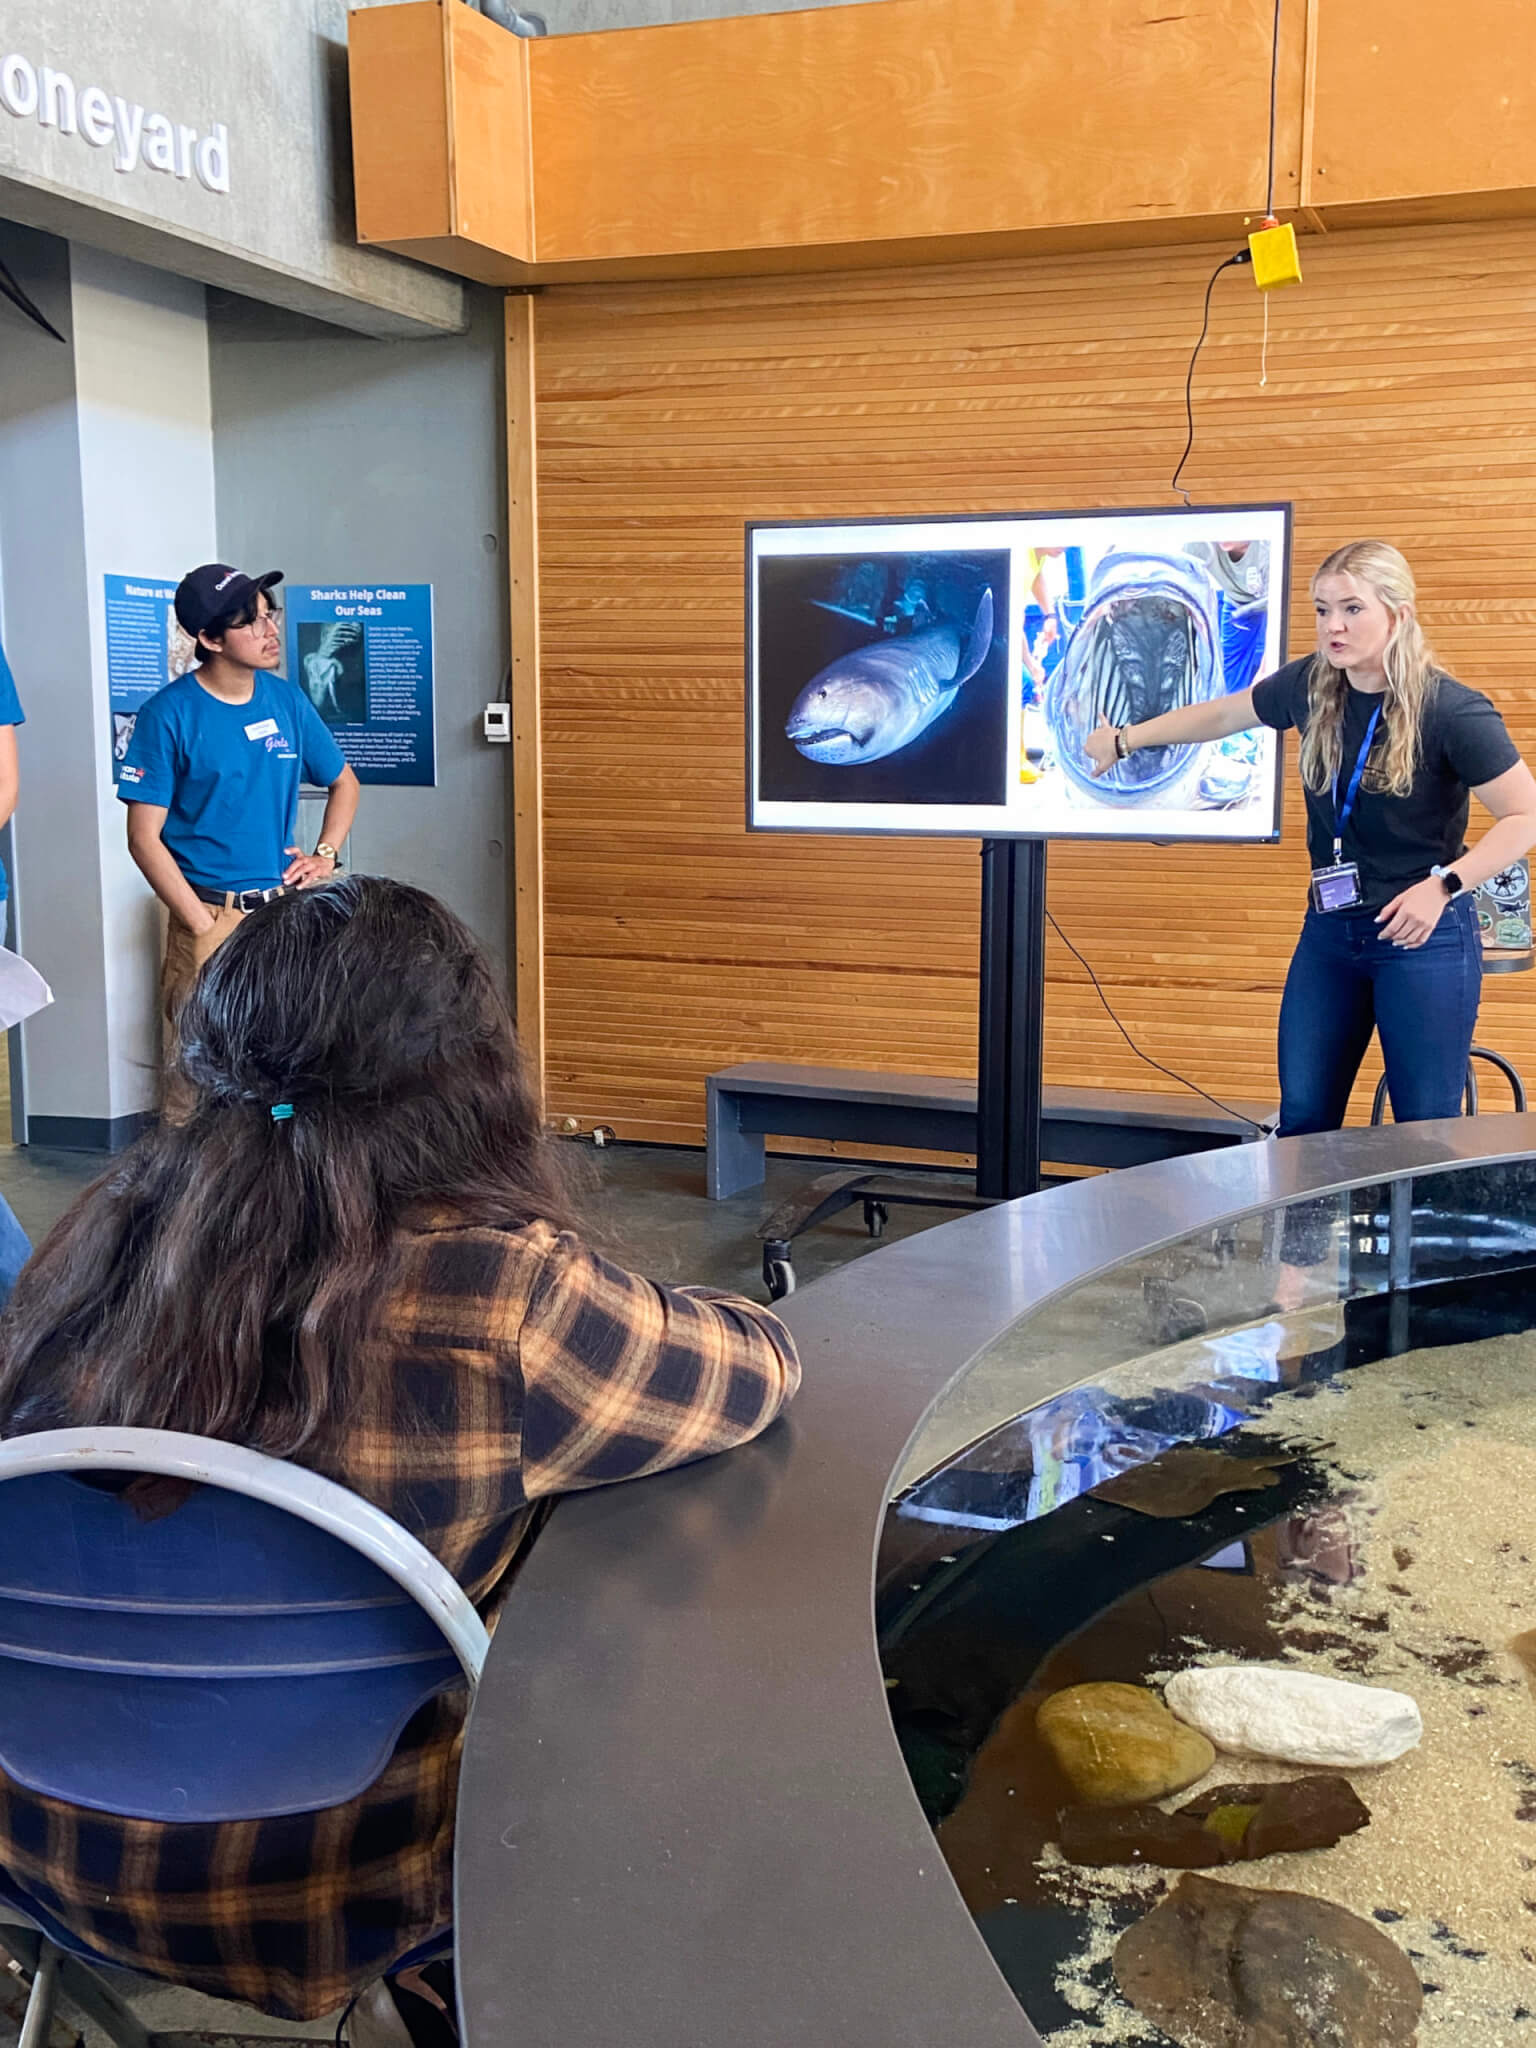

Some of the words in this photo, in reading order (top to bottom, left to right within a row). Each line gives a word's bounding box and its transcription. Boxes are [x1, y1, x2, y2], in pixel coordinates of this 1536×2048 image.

[1, 54, 230, 193] oneyard
[311, 589, 347, 600] Sharks
[349, 589, 374, 603] Help
[376, 589, 406, 600] Clean
[335, 605, 356, 616] Our
[357, 605, 383, 616] Seas
